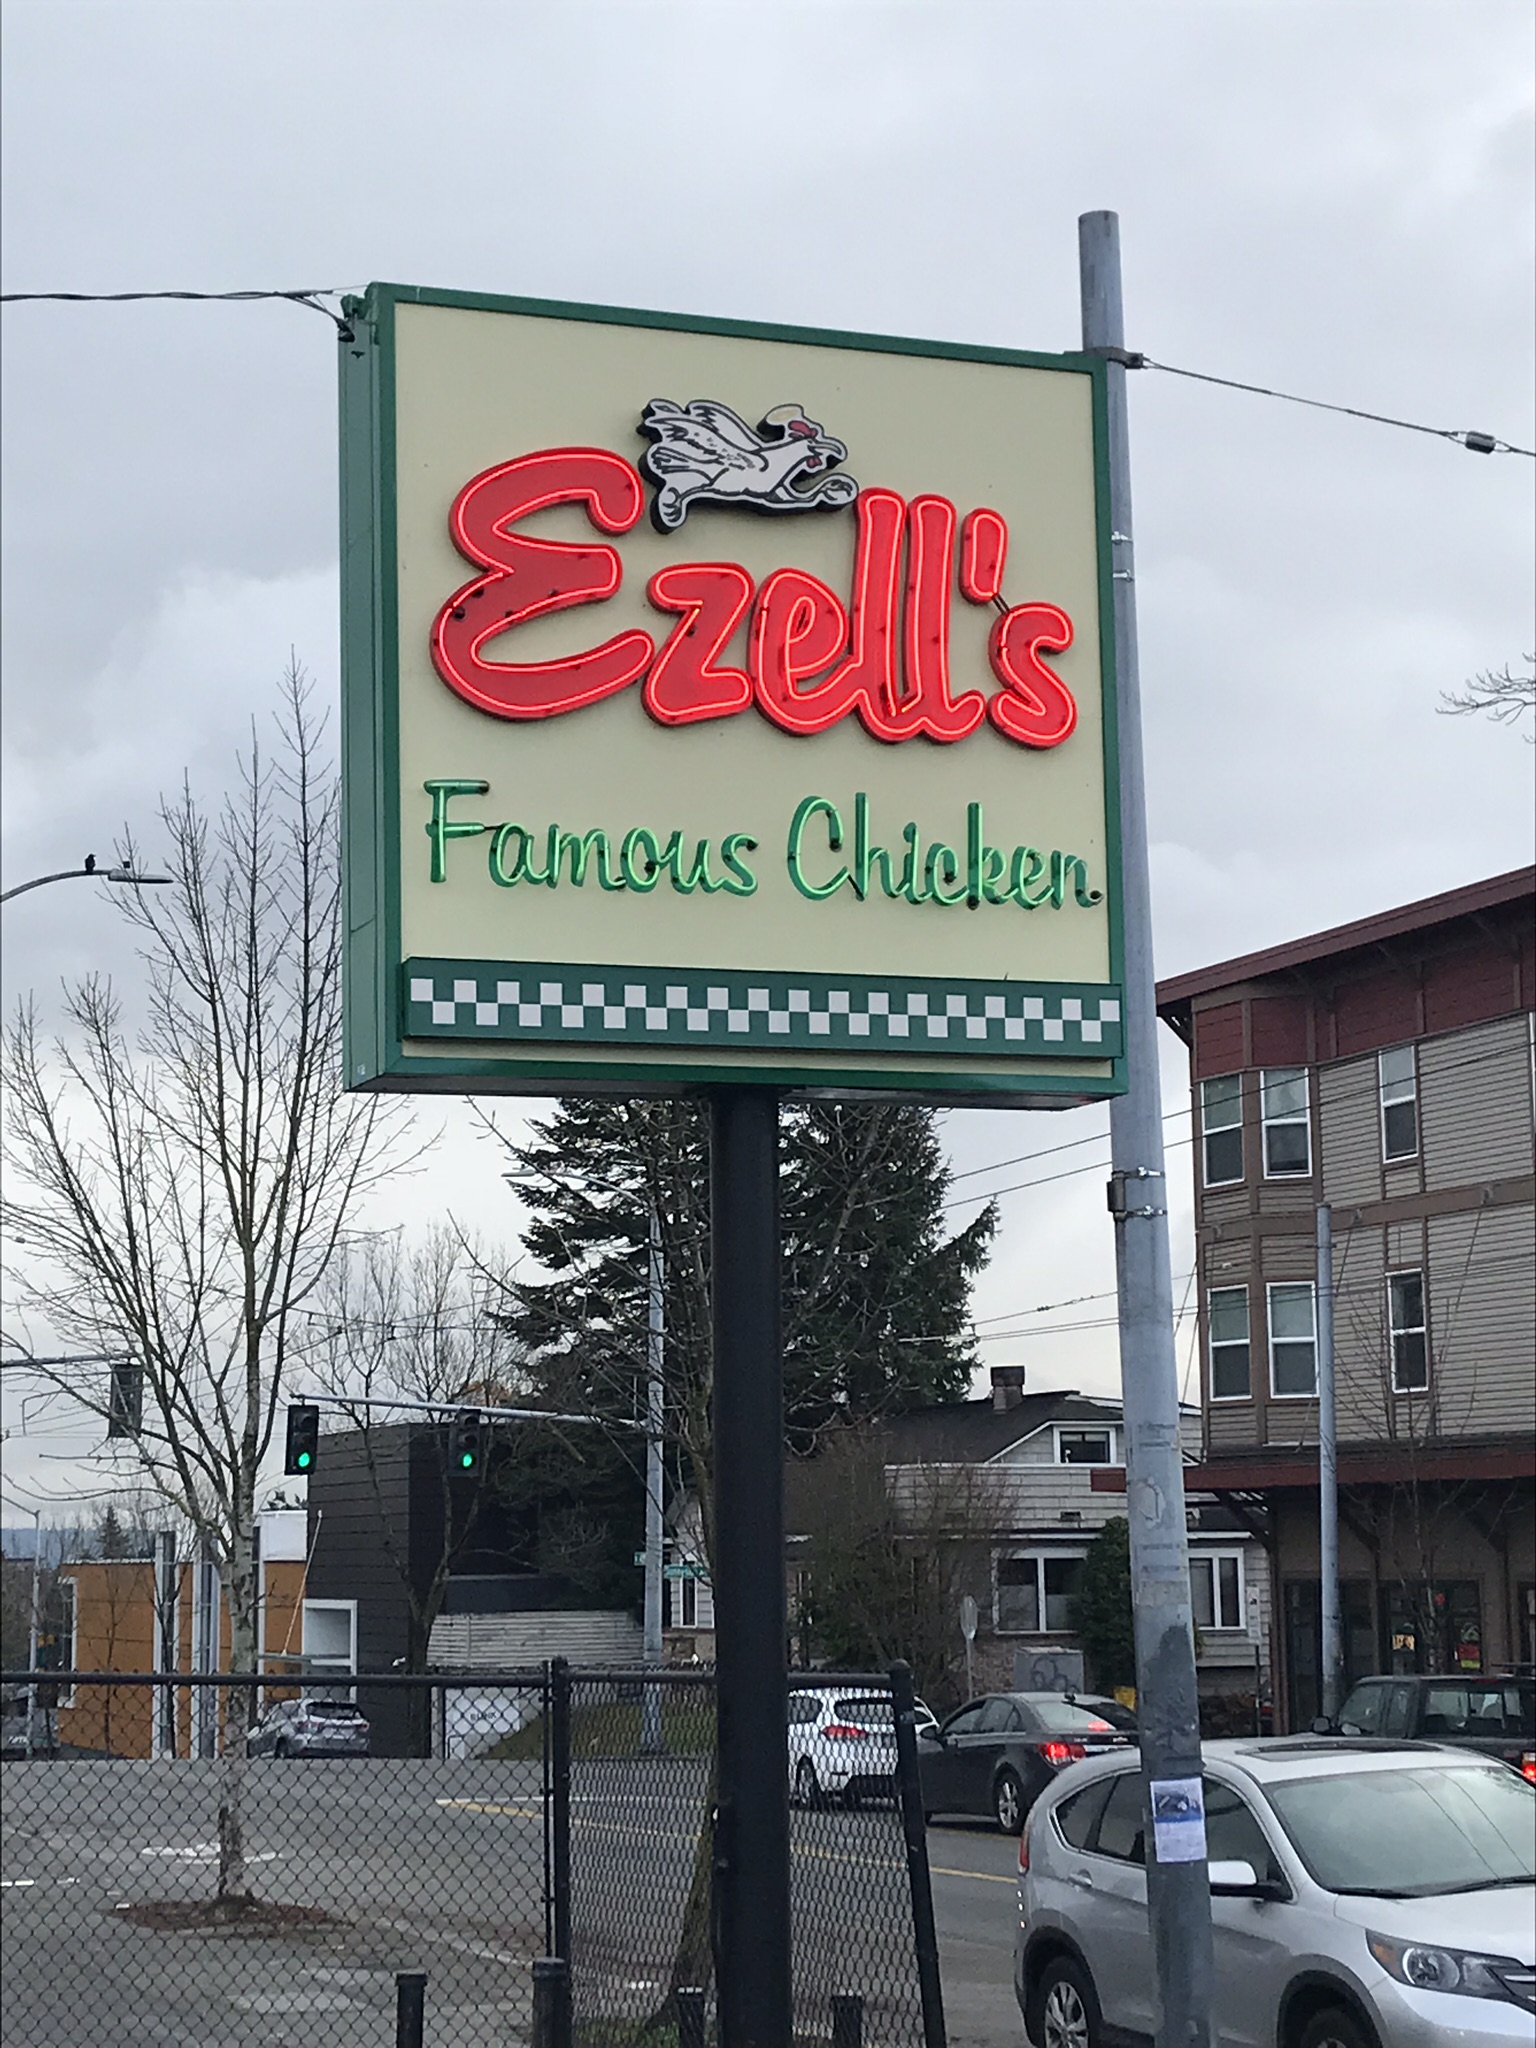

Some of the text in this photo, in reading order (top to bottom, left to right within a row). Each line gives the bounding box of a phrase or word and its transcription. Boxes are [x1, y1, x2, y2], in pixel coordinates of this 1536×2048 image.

[430, 446, 1078, 749] Ezell's
[423, 779, 1104, 910] Famous Chicken
